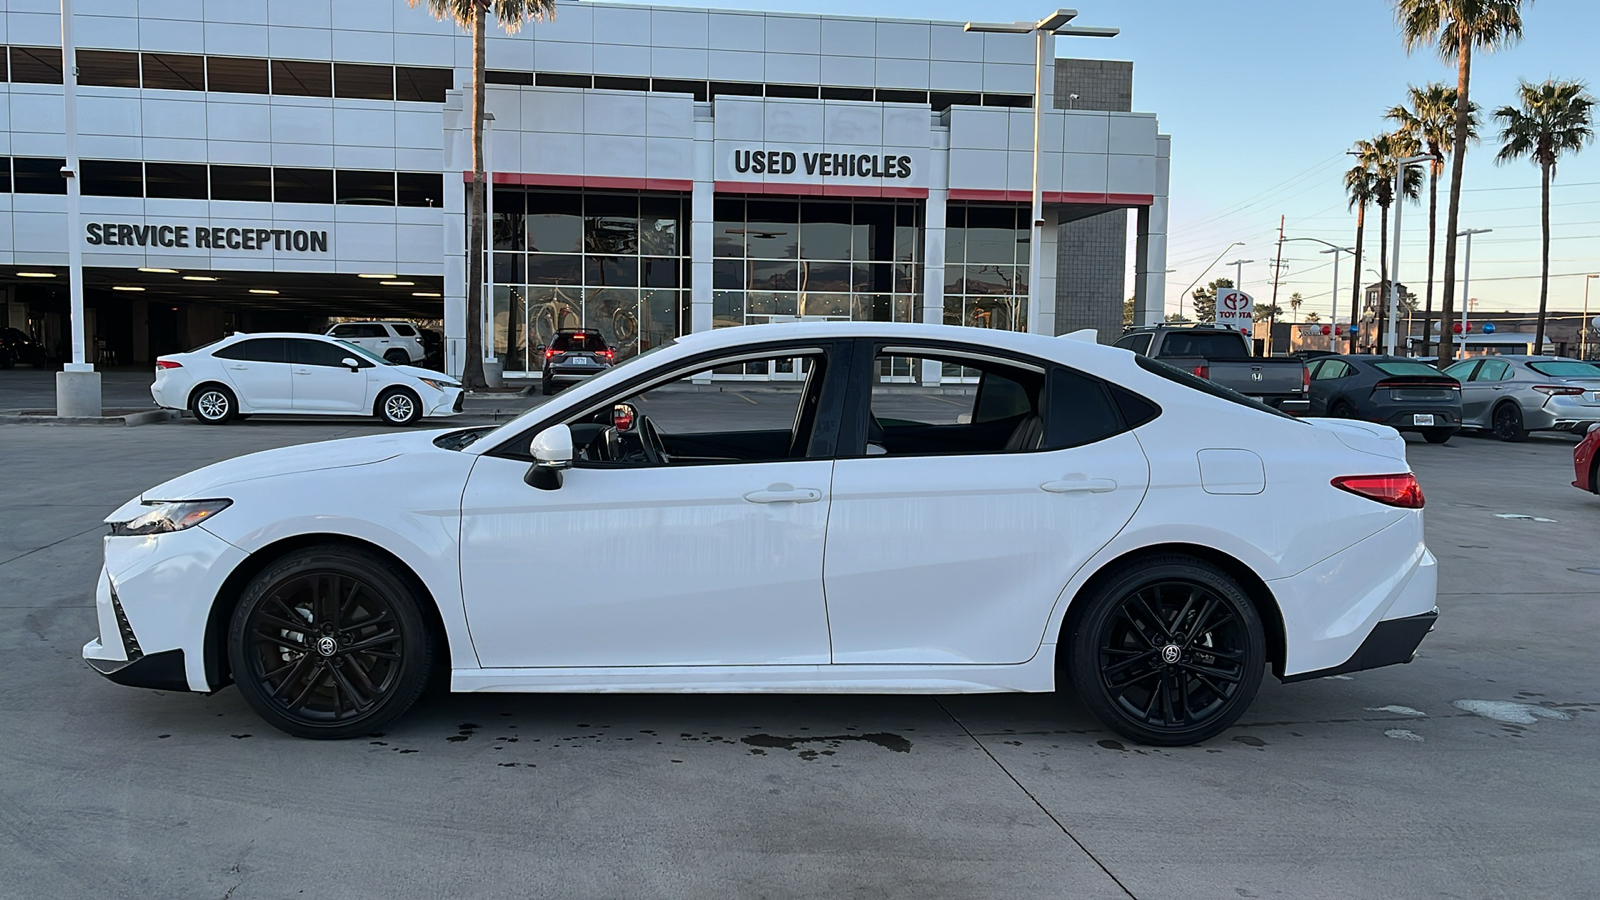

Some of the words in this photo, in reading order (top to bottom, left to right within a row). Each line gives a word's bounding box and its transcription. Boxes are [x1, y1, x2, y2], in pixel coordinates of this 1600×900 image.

[735, 150, 797, 175] USED
[802, 152, 912, 178] VEHICLES
[86, 223, 189, 248] SERVICE
[195, 227, 328, 252] RECEPTION
